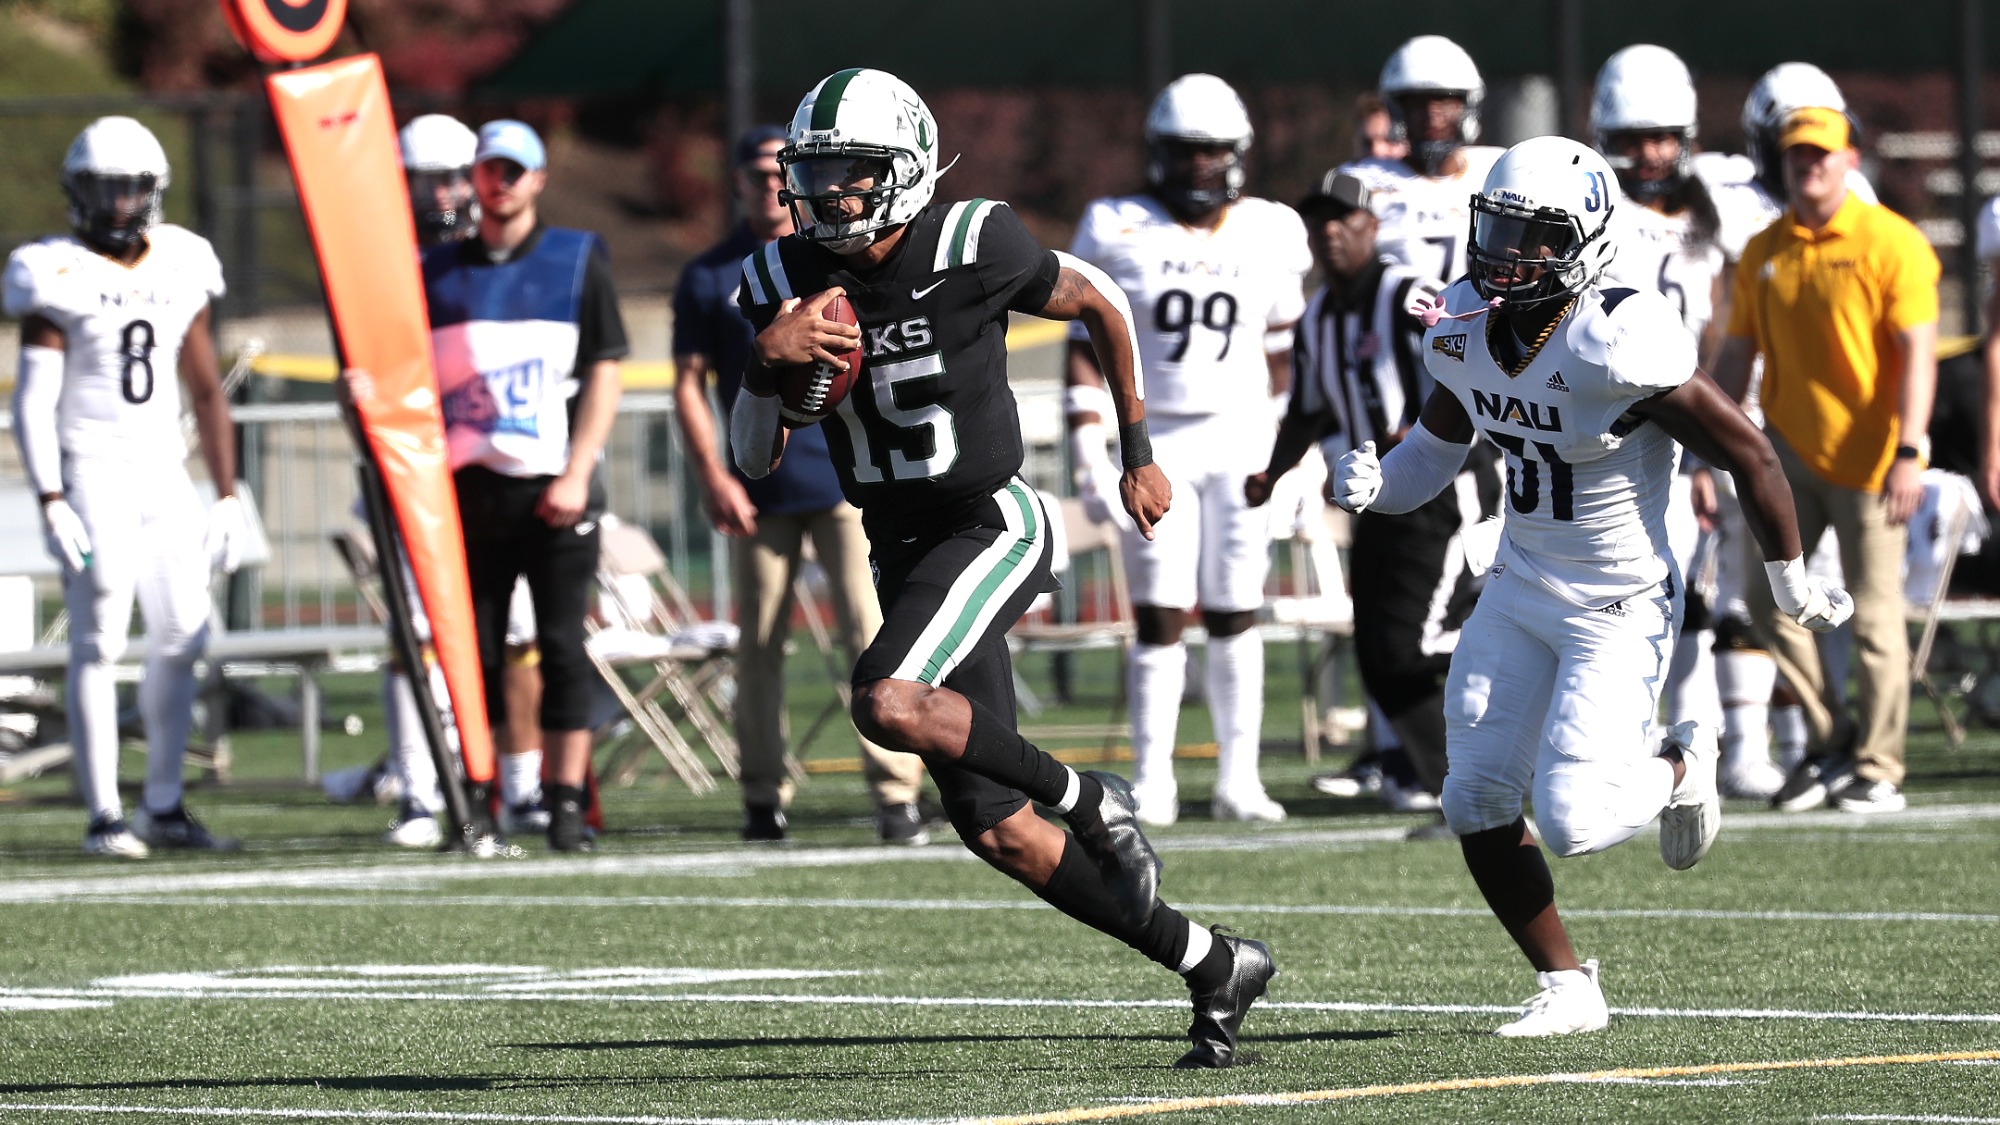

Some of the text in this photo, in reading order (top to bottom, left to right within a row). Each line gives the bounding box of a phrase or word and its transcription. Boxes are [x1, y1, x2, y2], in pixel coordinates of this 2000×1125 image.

[1502, 191, 1526, 203] NAU
[1584, 171, 1609, 211] 31
[861, 316, 932, 358] KS
[1156, 289, 1238, 363] 99
[121, 319, 154, 405] 8
[1546, 382, 1570, 392] adidas
[836, 350, 960, 483] 15
[1470, 388, 1562, 433] NAU
[1484, 428, 1573, 521] 31
